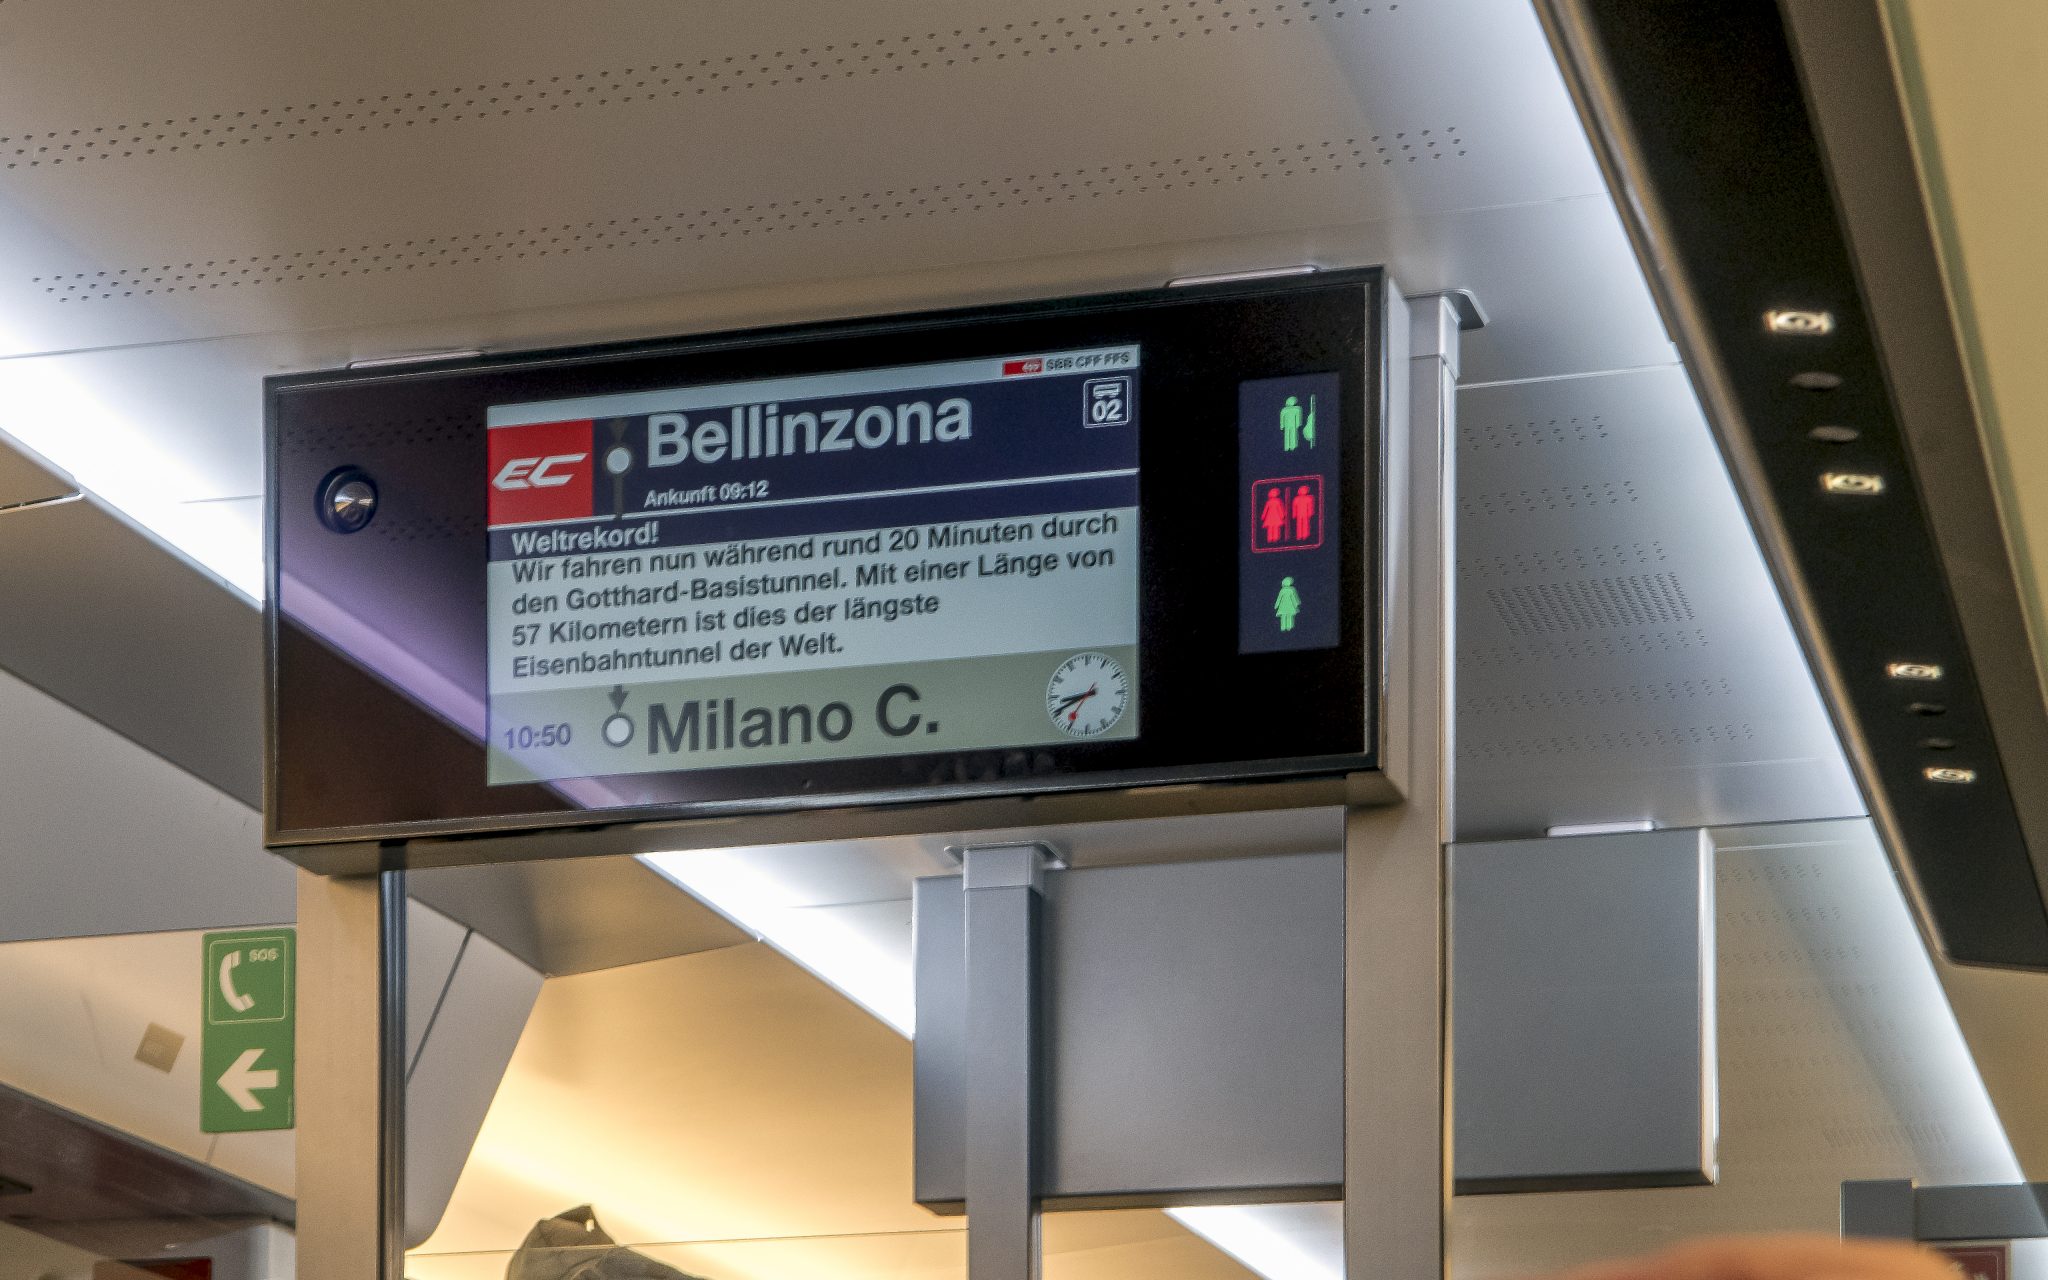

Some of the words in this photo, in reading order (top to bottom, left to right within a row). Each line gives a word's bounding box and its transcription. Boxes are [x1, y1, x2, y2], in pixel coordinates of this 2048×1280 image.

[1047, 358, 1073, 371] SBB
[1092, 399, 1122, 422] 02
[648, 397, 972, 468] Bellinzona
[492, 453, 588, 491] EC
[644, 485, 717, 508] Ankunft
[720, 480, 769, 502] 09:12
[512, 521, 659, 556] Weltrekord!
[512, 561, 554, 584] Wir
[562, 554, 641, 579] fahren
[650, 552, 695, 573] nun
[704, 537, 813, 567] während
[822, 532, 880, 558] rund
[889, 528, 918, 551] 20
[928, 521, 1032, 549] Minuten
[1041, 511, 1117, 540] durch
[512, 593, 557, 615] den
[566, 568, 847, 611] Gotthard-Basistunnel.
[856, 562, 896, 587] Mit
[904, 559, 970, 584] einer
[978, 551, 1058, 579] Länge
[1066, 548, 1114, 570] von
[512, 624, 540, 646] 57
[550, 616, 687, 644] Kilometern
[695, 610, 726, 632] ist
[733, 605, 785, 629] dies
[794, 600, 837, 624] der
[845, 594, 940, 622] längste
[512, 641, 721, 678] Eisenbahntunnel
[729, 639, 771, 660] der
[779, 632, 843, 657] Welt.
[504, 722, 571, 750] 10:50
[648, 698, 852, 756] Milano
[876, 683, 940, 737] C.
[249, 948, 279, 962] SOS
